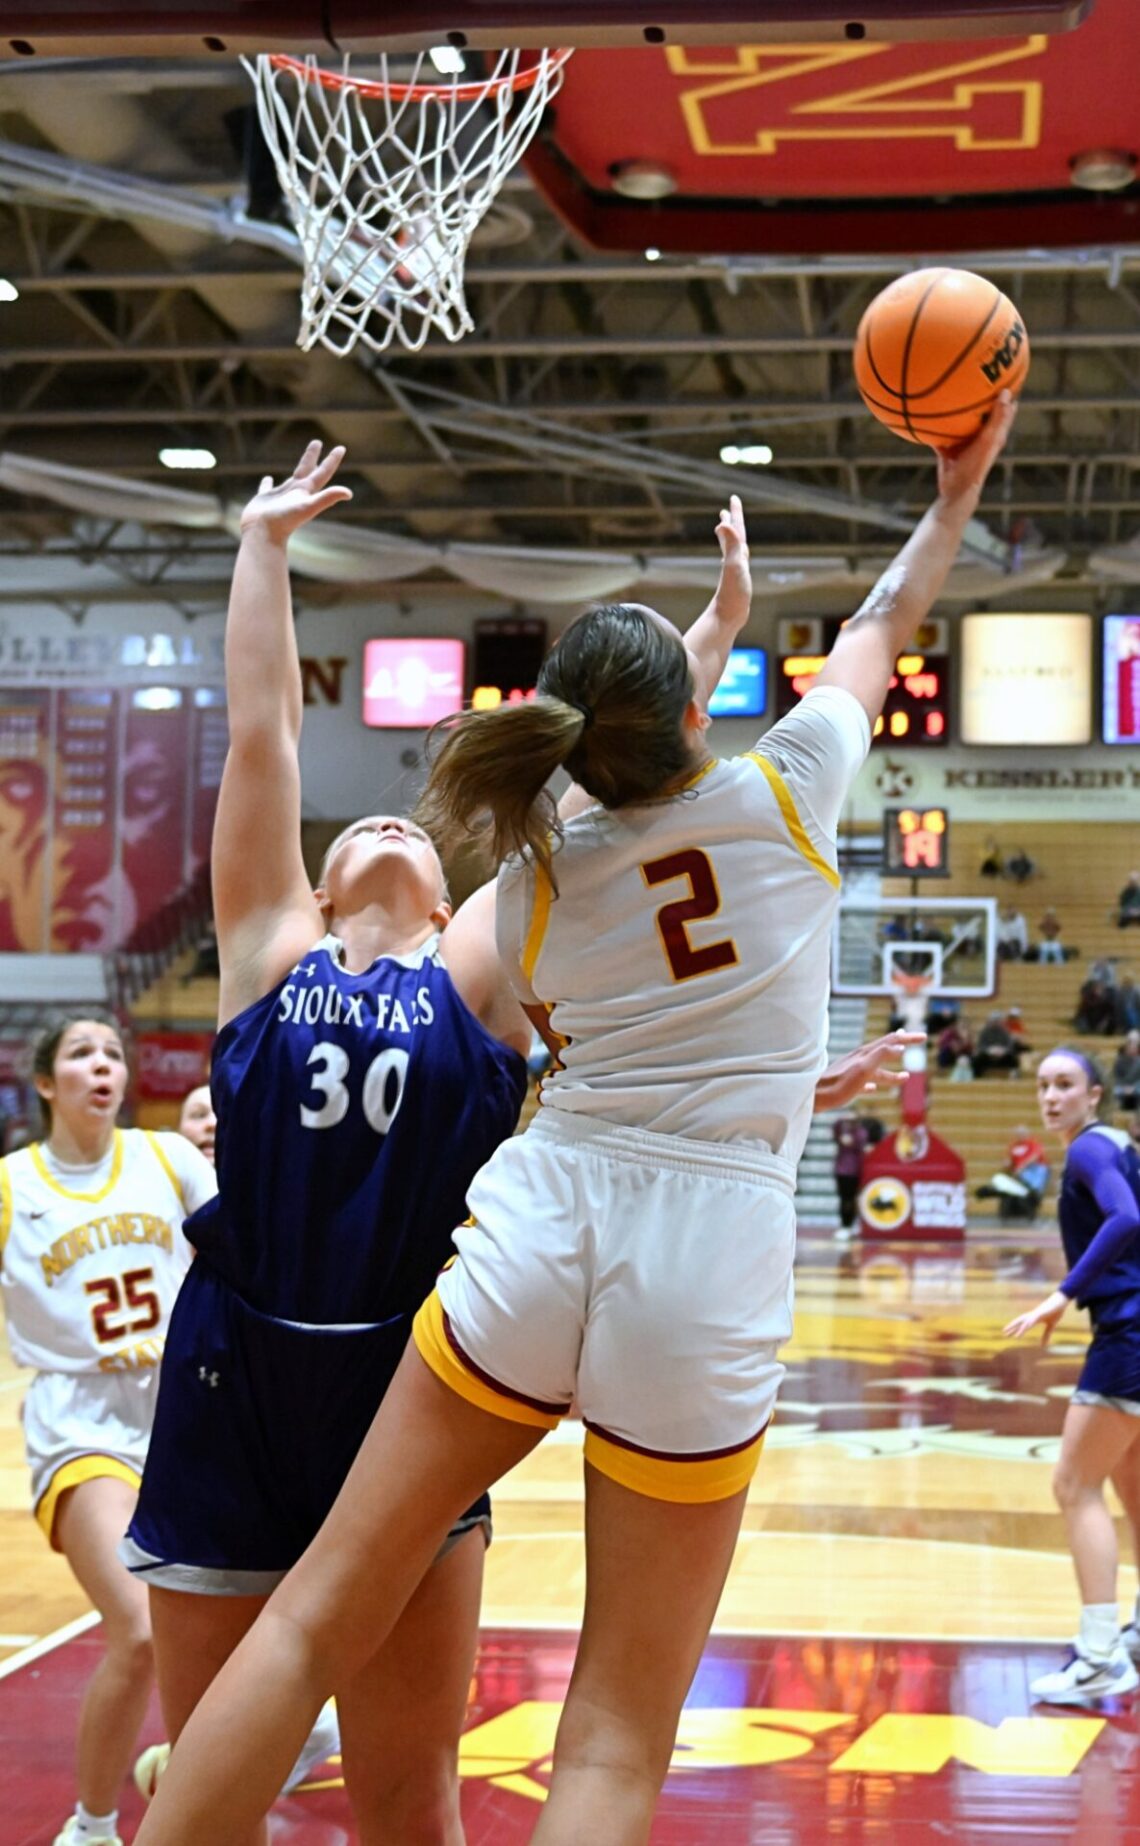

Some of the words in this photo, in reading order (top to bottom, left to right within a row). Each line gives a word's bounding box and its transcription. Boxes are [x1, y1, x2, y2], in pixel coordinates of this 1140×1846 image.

[666, 34, 1047, 154] N
[981, 320, 1024, 384] NCAA
[299, 656, 349, 707] N
[638, 846, 742, 986] 2
[277, 984, 364, 1028] SIOUX
[300, 1040, 410, 1136] 30
[39, 1212, 174, 1288] NORTHERN
[82, 1266, 162, 1344] 25
